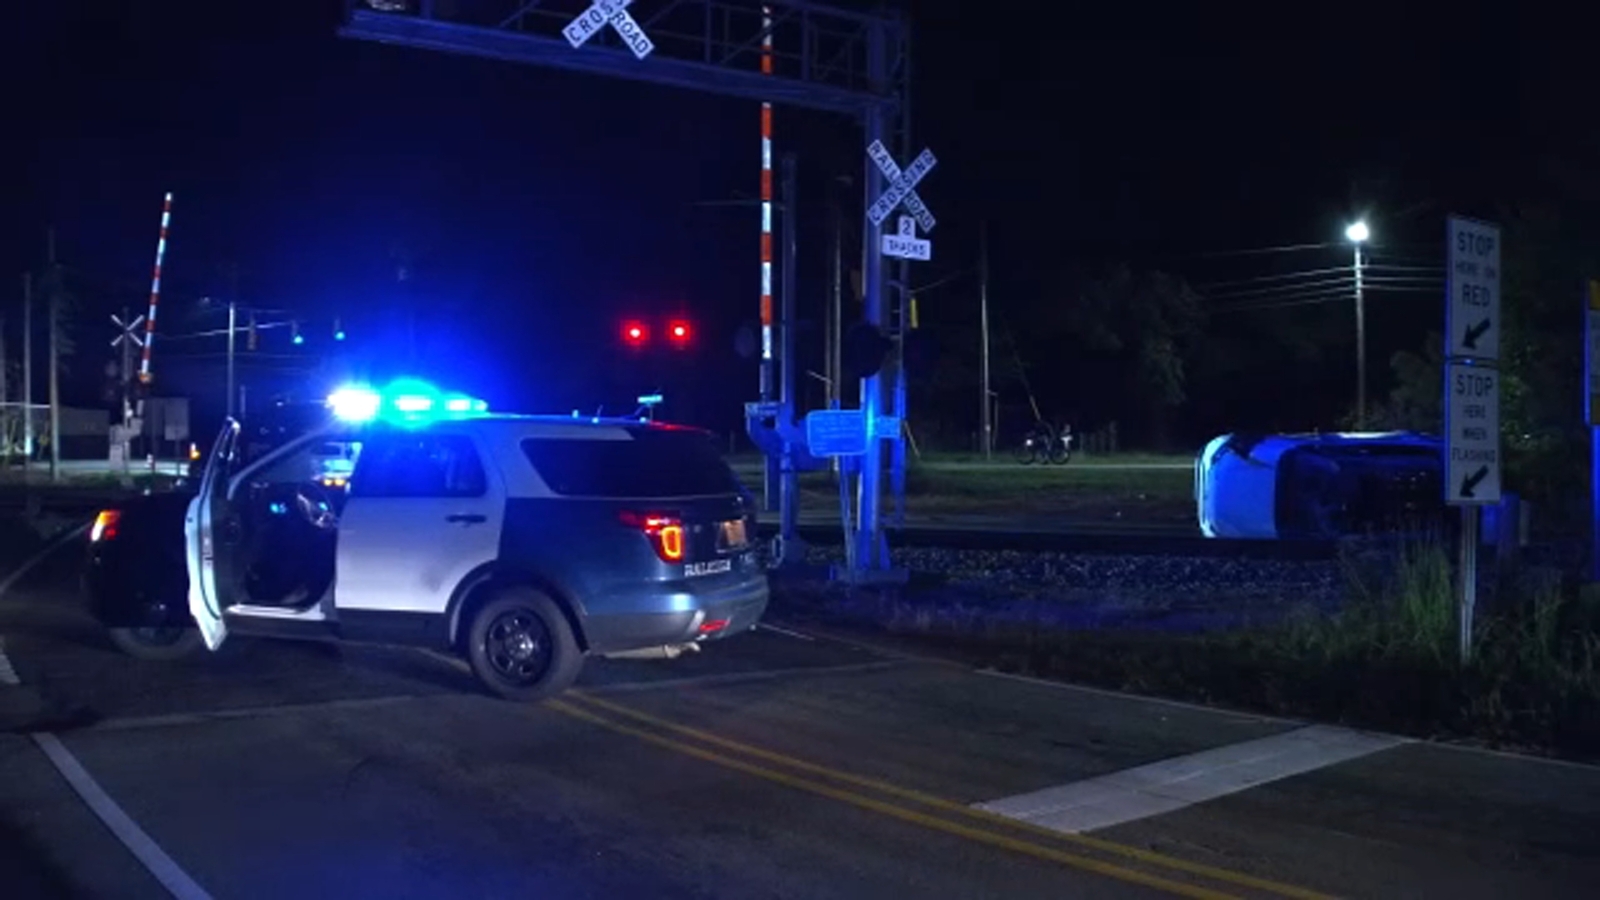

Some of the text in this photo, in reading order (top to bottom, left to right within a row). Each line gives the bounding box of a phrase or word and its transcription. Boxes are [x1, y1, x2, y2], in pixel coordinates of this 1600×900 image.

[608, 12, 649, 53] ROAD
[870, 142, 899, 183] RAIL
[871, 151, 934, 221] CROSSING
[902, 220, 911, 235] 2
[1457, 231, 1495, 256] STOP
[1462, 284, 1490, 307] RED
[1457, 374, 1493, 397] STOP
[1463, 404, 1486, 419] HERE
[1463, 427, 1487, 440] WHEN
[1452, 447, 1496, 463] FLASHING
